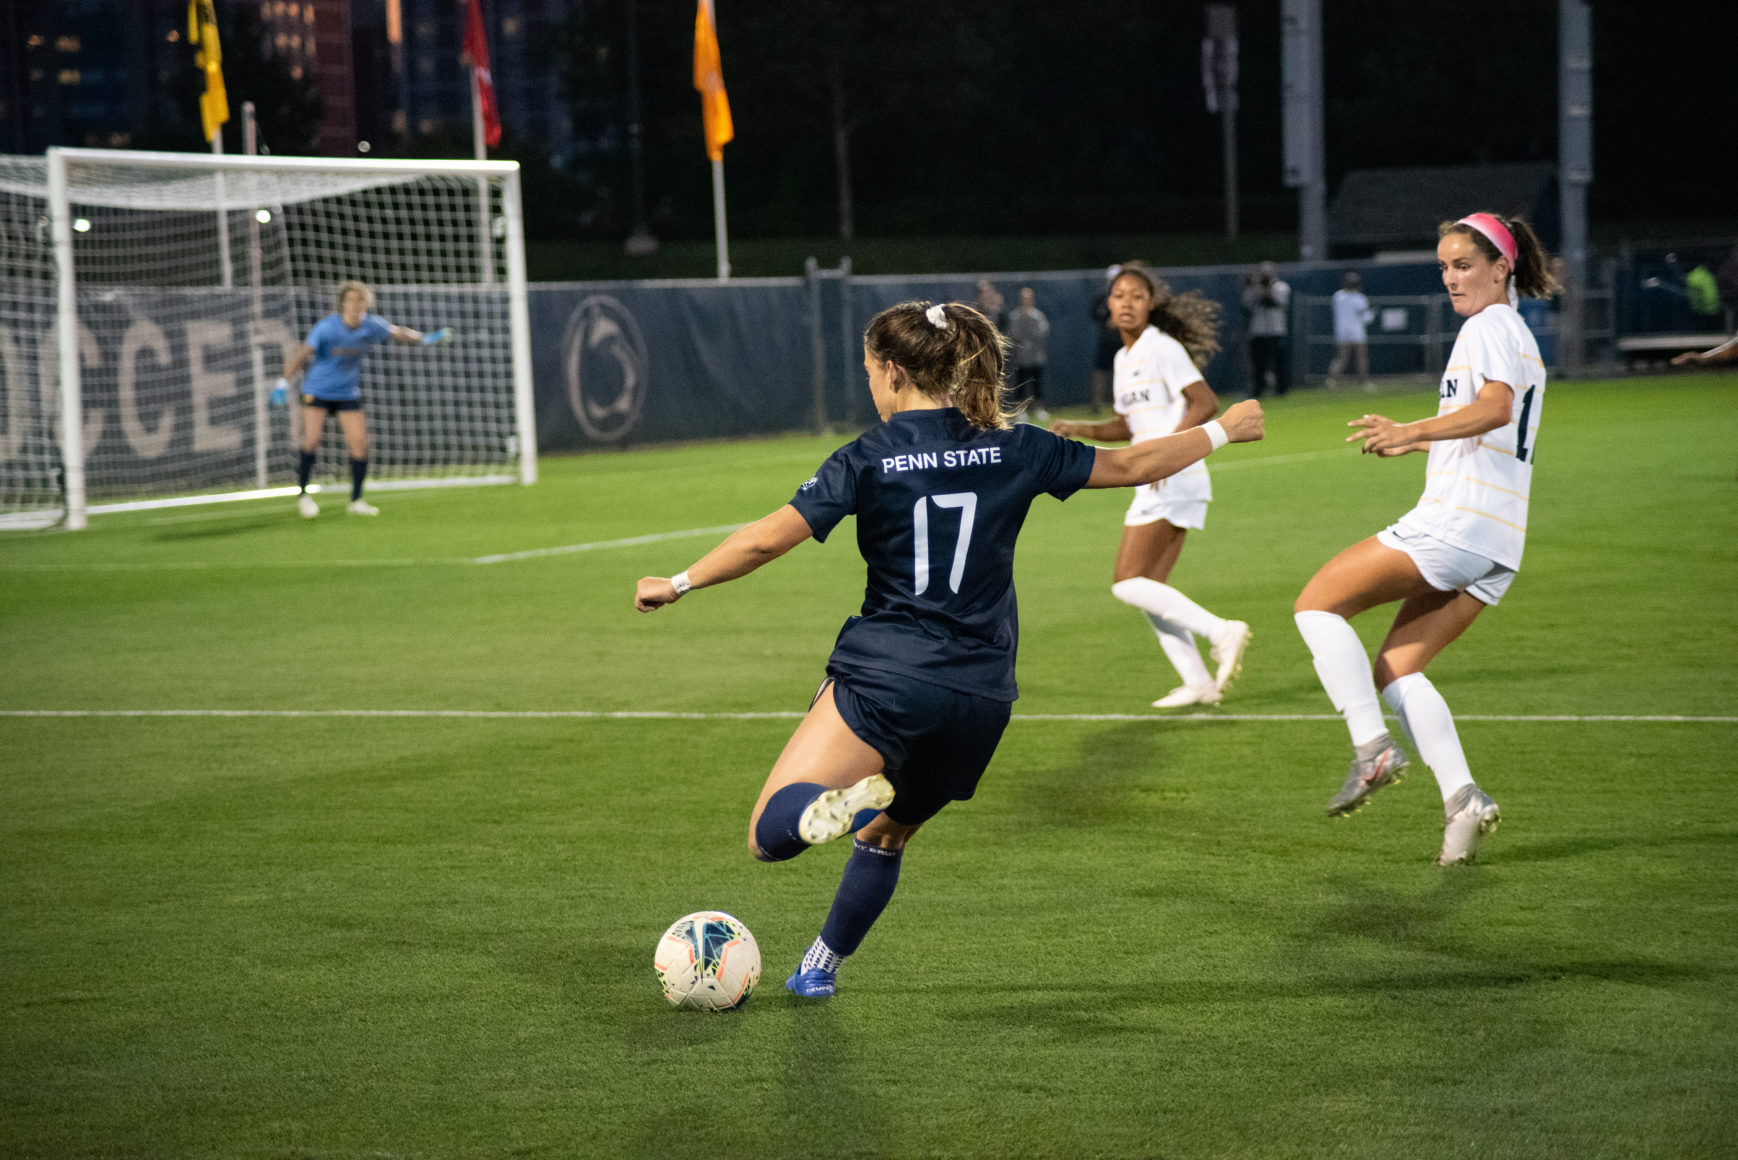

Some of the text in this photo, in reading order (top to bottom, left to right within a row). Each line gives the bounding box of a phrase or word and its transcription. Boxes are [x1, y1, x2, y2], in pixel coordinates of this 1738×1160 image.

[882, 447, 1002, 473] PENN STATE
[1516, 384, 1535, 464] 1
[913, 491, 978, 596] 17
